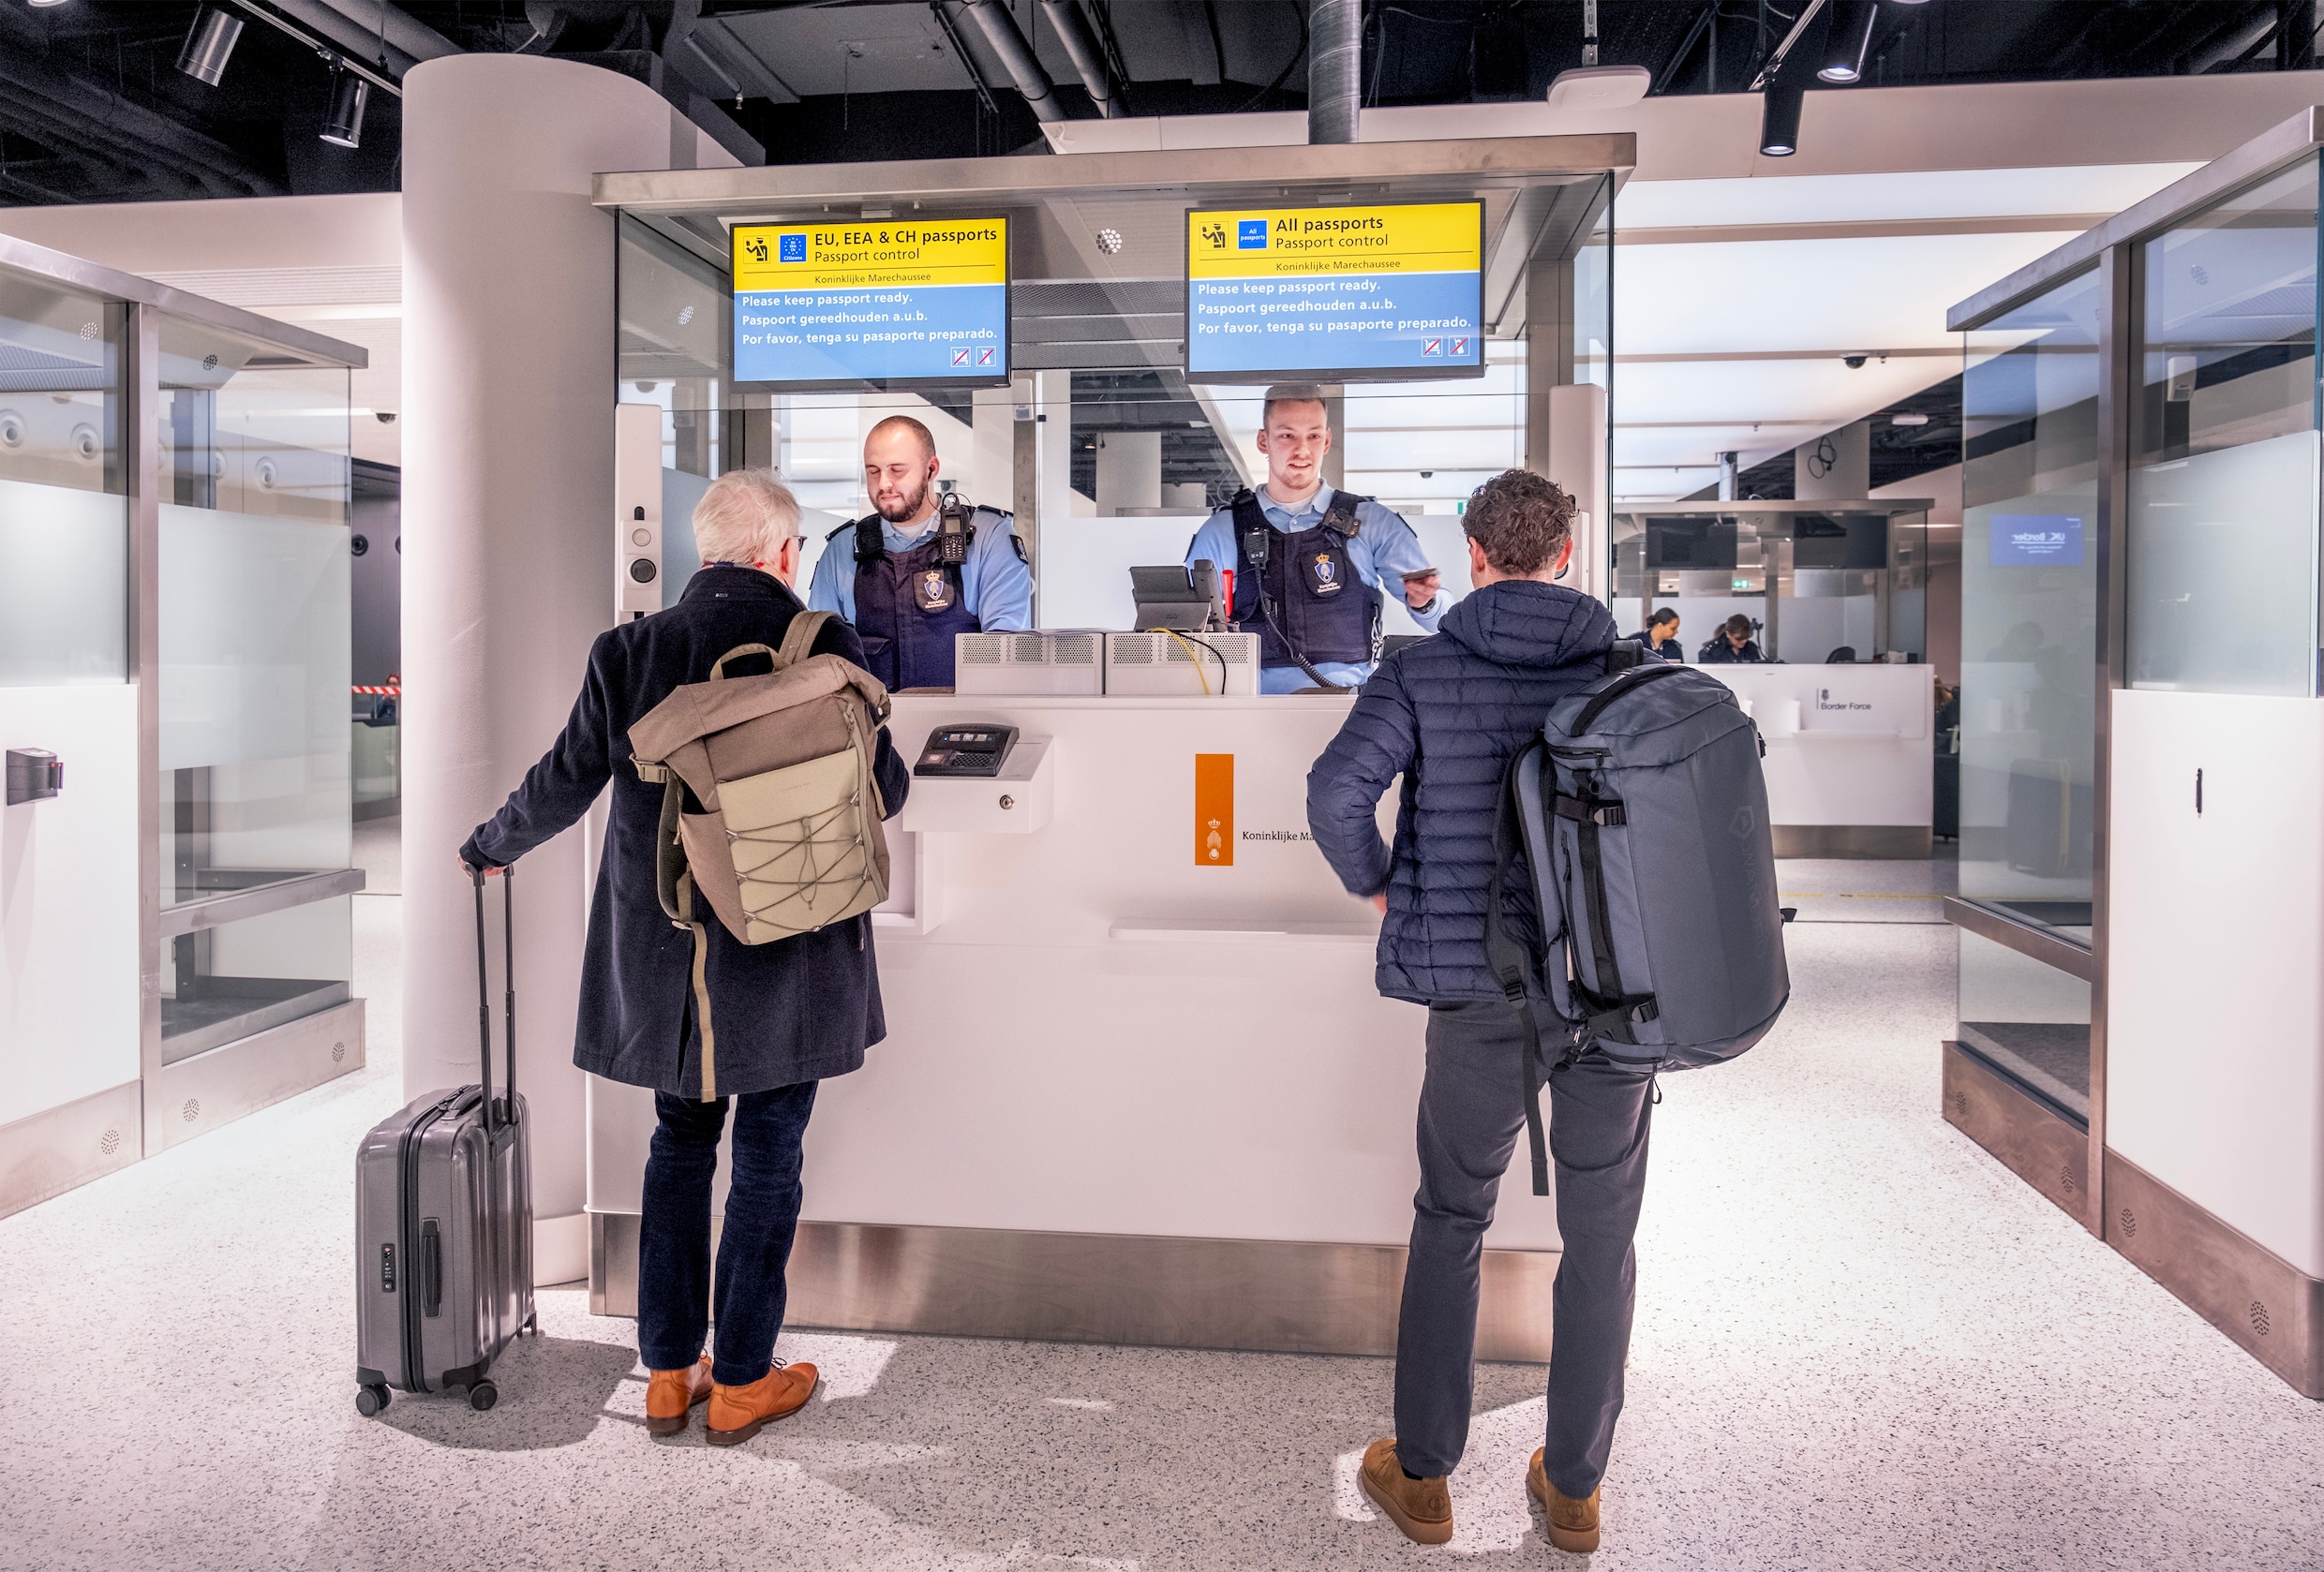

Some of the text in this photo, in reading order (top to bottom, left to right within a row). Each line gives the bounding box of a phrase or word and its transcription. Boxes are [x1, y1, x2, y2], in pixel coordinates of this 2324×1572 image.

[1275, 216, 1383, 234] All passports
[815, 229, 997, 247] EU, EEA & CH passports
[1276, 233, 1388, 251] Passport control
[814, 247, 919, 264] Passport control
[1276, 260, 1402, 272] Koninklijke Marechaussee
[814, 273, 931, 285] Koninklijke Marechaussee
[1198, 278, 1381, 296] Please keep passport ready.
[742, 290, 913, 308] Please keep passport ready.
[1198, 298, 1397, 317] Paspoort gereedhouden a.u.b.
[742, 309, 928, 328] Paspoort gereedhouden a.u.b.
[1199, 316, 1471, 335] Por favor, tenga su pasaporte preparado.
[742, 327, 998, 346] Por favor, tenga su pasaporte preparado.
[1821, 702, 1872, 710] Border Force
[1242, 830, 1298, 843] Koninklijke
